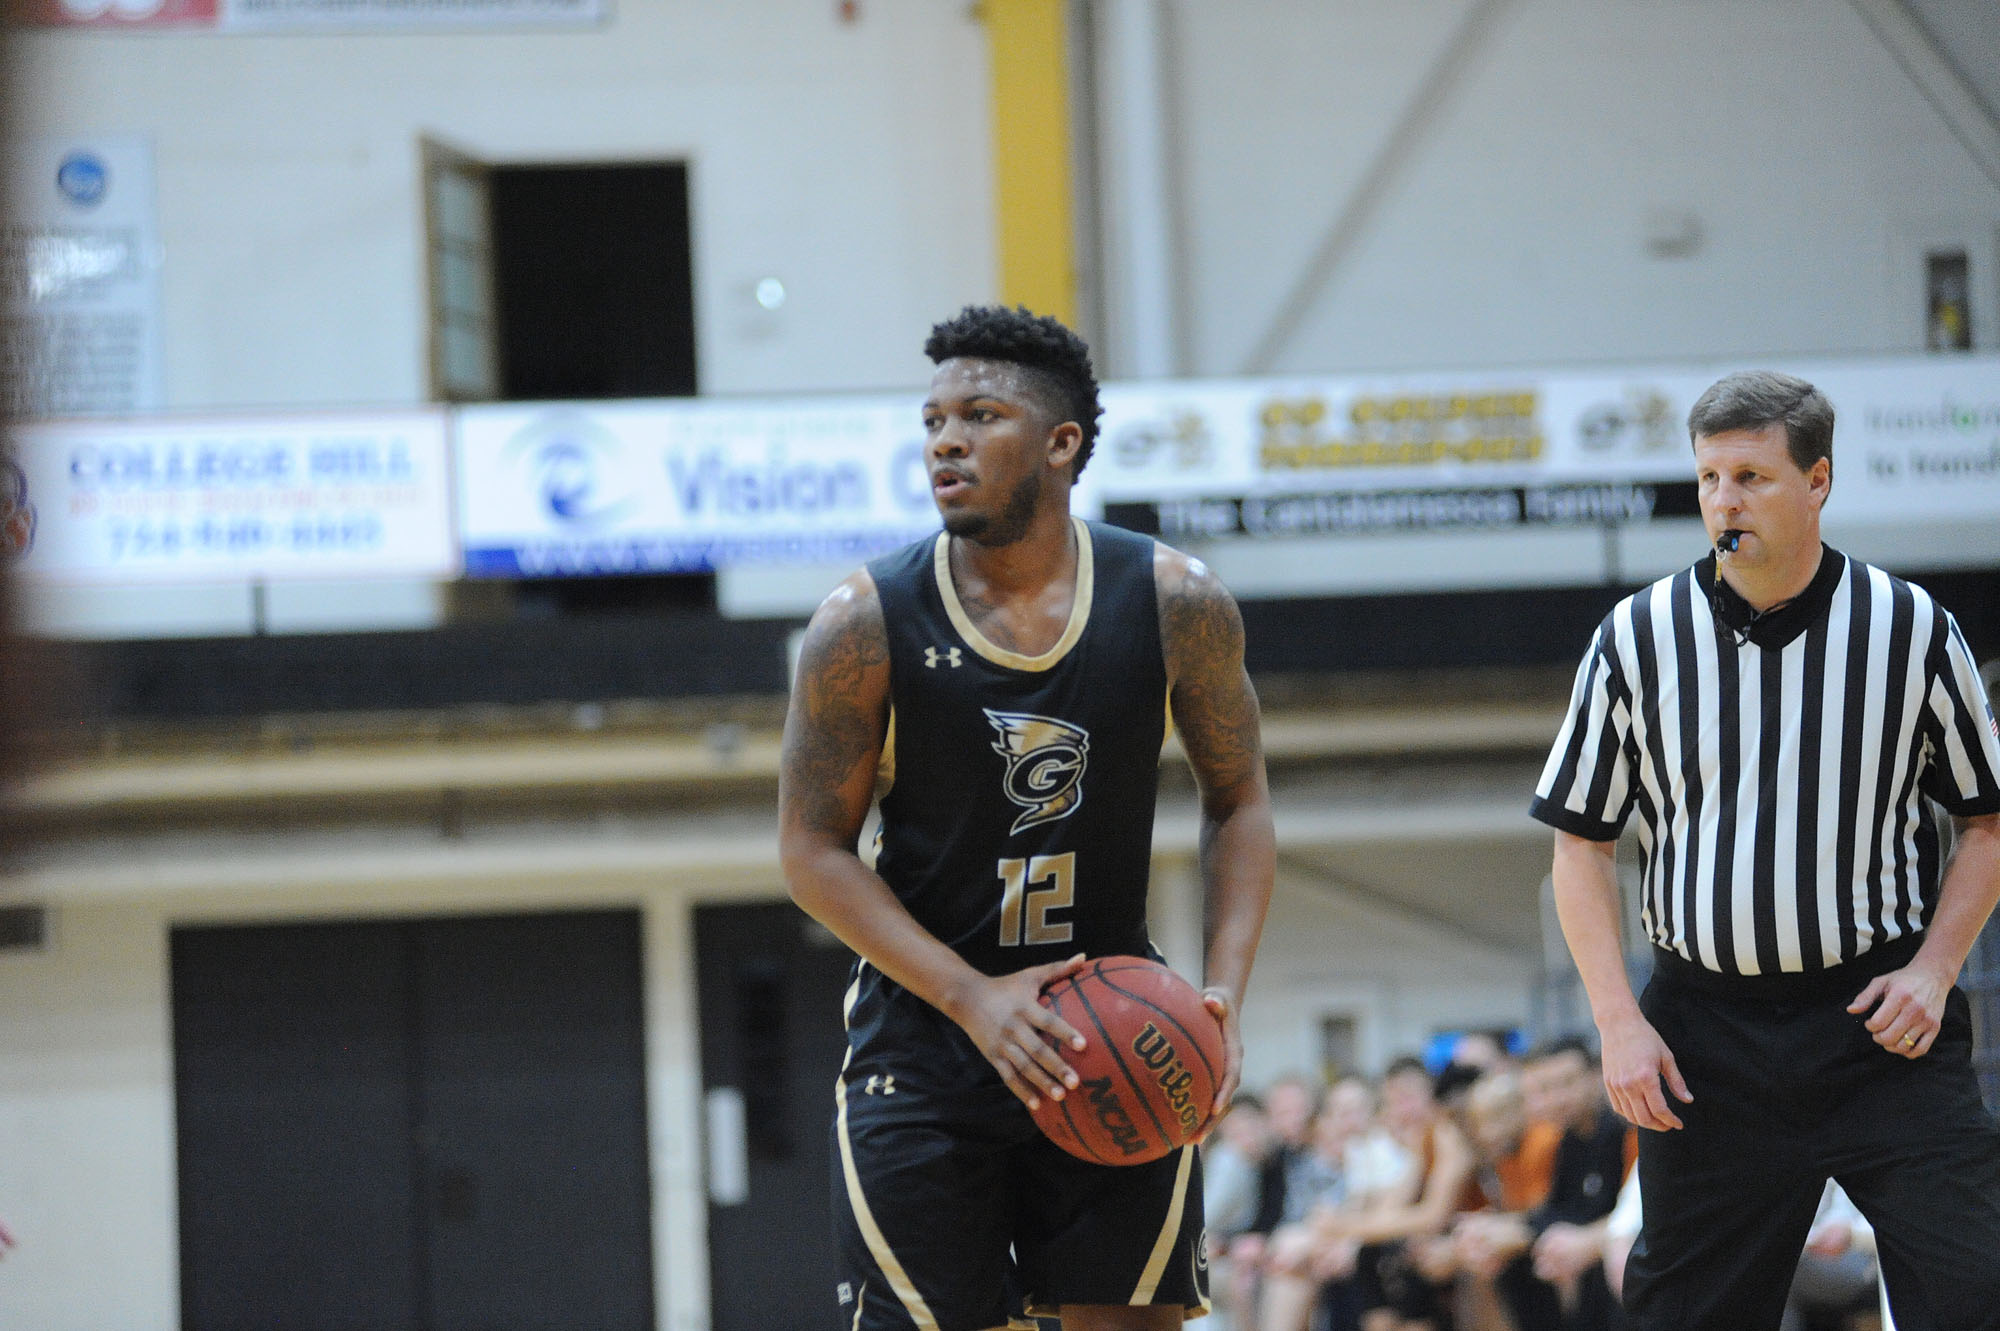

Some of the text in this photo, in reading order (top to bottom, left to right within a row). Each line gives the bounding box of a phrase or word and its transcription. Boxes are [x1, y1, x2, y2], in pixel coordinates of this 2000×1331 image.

[70, 443, 413, 480] COLLEGE HILL
[667, 445, 864, 516] Vision
[997, 851, 1075, 947] 12
[1082, 1076, 1148, 1155] NCAA
